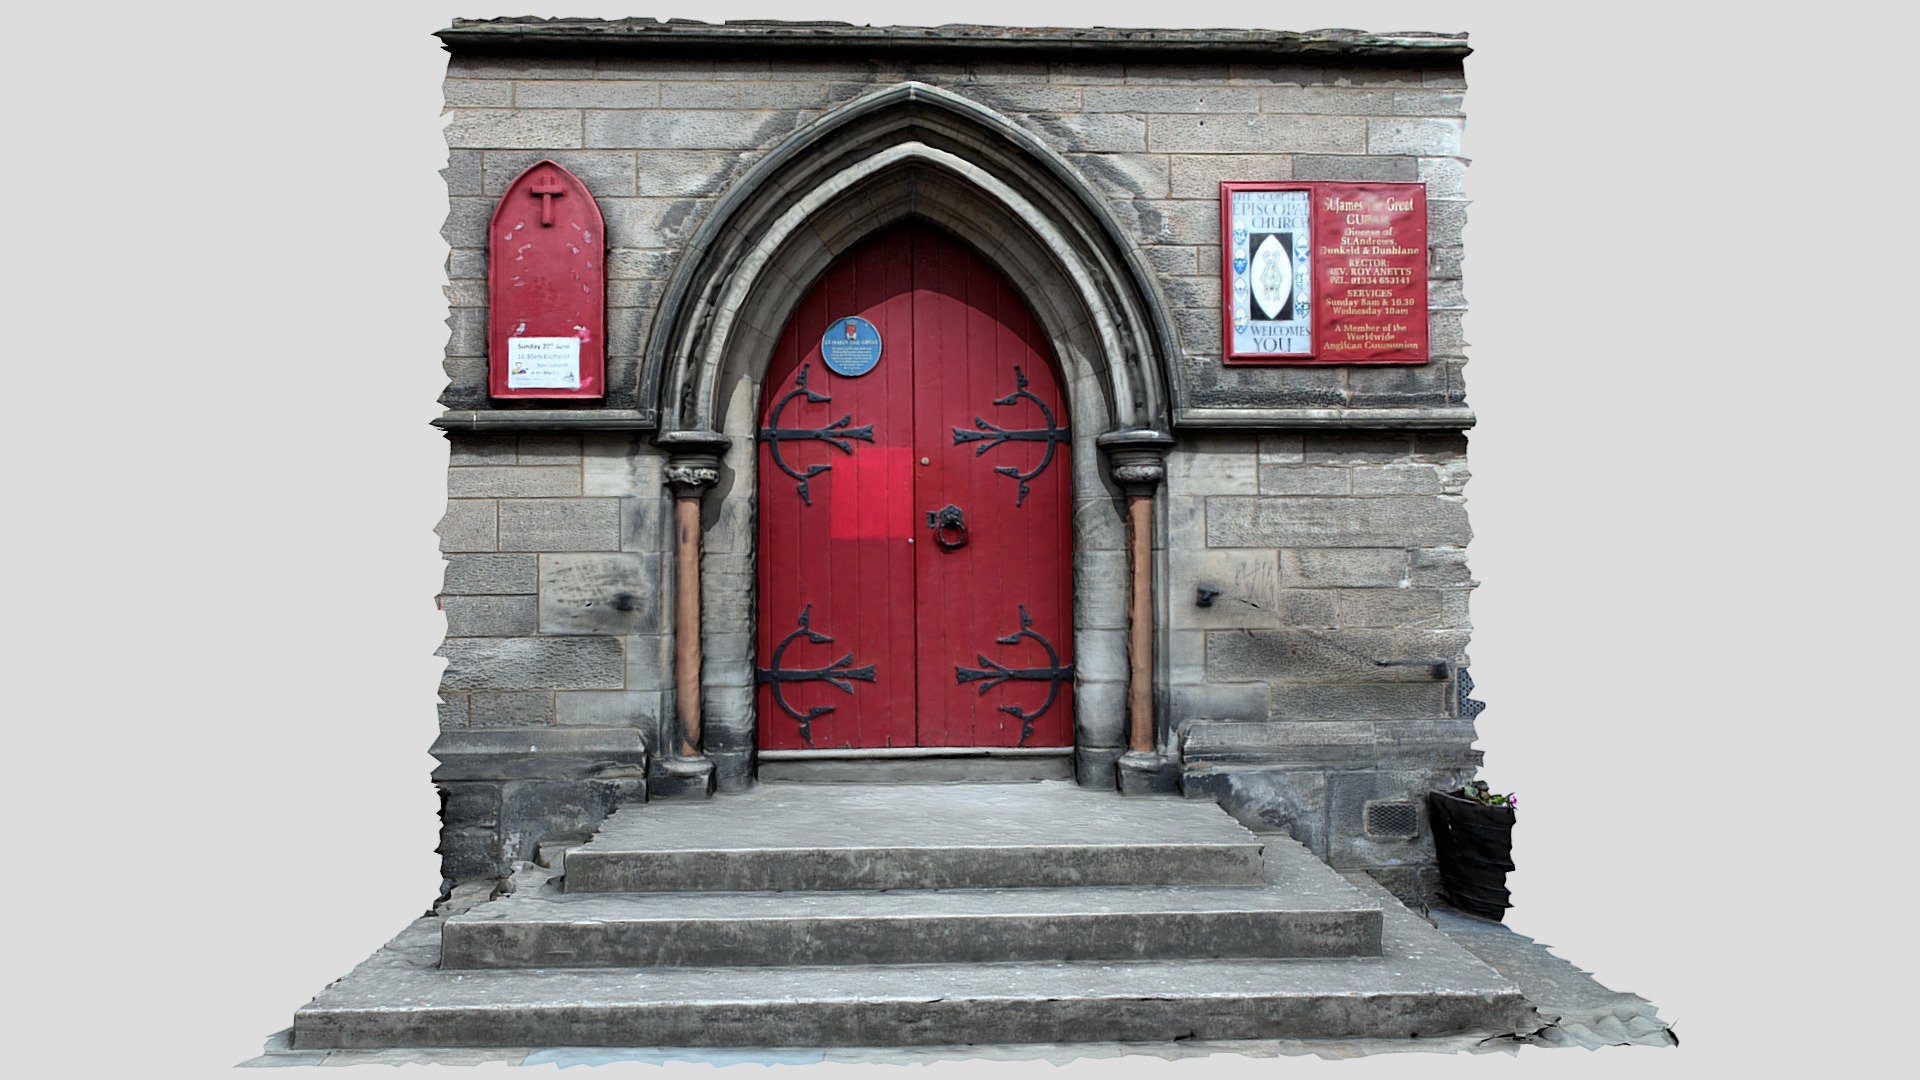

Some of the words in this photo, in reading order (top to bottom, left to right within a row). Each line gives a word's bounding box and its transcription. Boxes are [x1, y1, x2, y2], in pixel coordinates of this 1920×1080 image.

[1386, 196, 1414, 211] Great
[1233, 202, 1309, 216] EPISCOPAL
[1252, 216, 1310, 229] CHURCH
[1344, 227, 1380, 236] Diocese
[1382, 226, 1393, 236] of
[1321, 246, 1360, 255] Dunkeld
[1363, 246, 1370, 255] &
[1372, 246, 1420, 255] Dunblane
[1349, 259, 1390, 267] RECTOR:
[1351, 267, 1371, 276] ROY
[1351, 276, 1377, 285] 01334
[1347, 289, 1393, 298] SERVICES
[1326, 298, 1359, 307] Sunday
[1361, 298, 1380, 306] 8am
[1391, 298, 1415, 306] 10.30
[1333, 307, 1382, 316] Wednesday
[1385, 307, 1409, 315] 10am
[1251, 325, 1311, 336] WELCOMES
[1335, 324, 1341, 332] A
[1344, 324, 1380, 332] Member
[1382, 323, 1391, 332] of
[1393, 323, 1407, 332] the
[1347, 332, 1395, 341] Worldwide
[1254, 337, 1291, 352] YOU
[1323, 341, 1362, 351] Anglican
[1364, 341, 1419, 350] Communion
